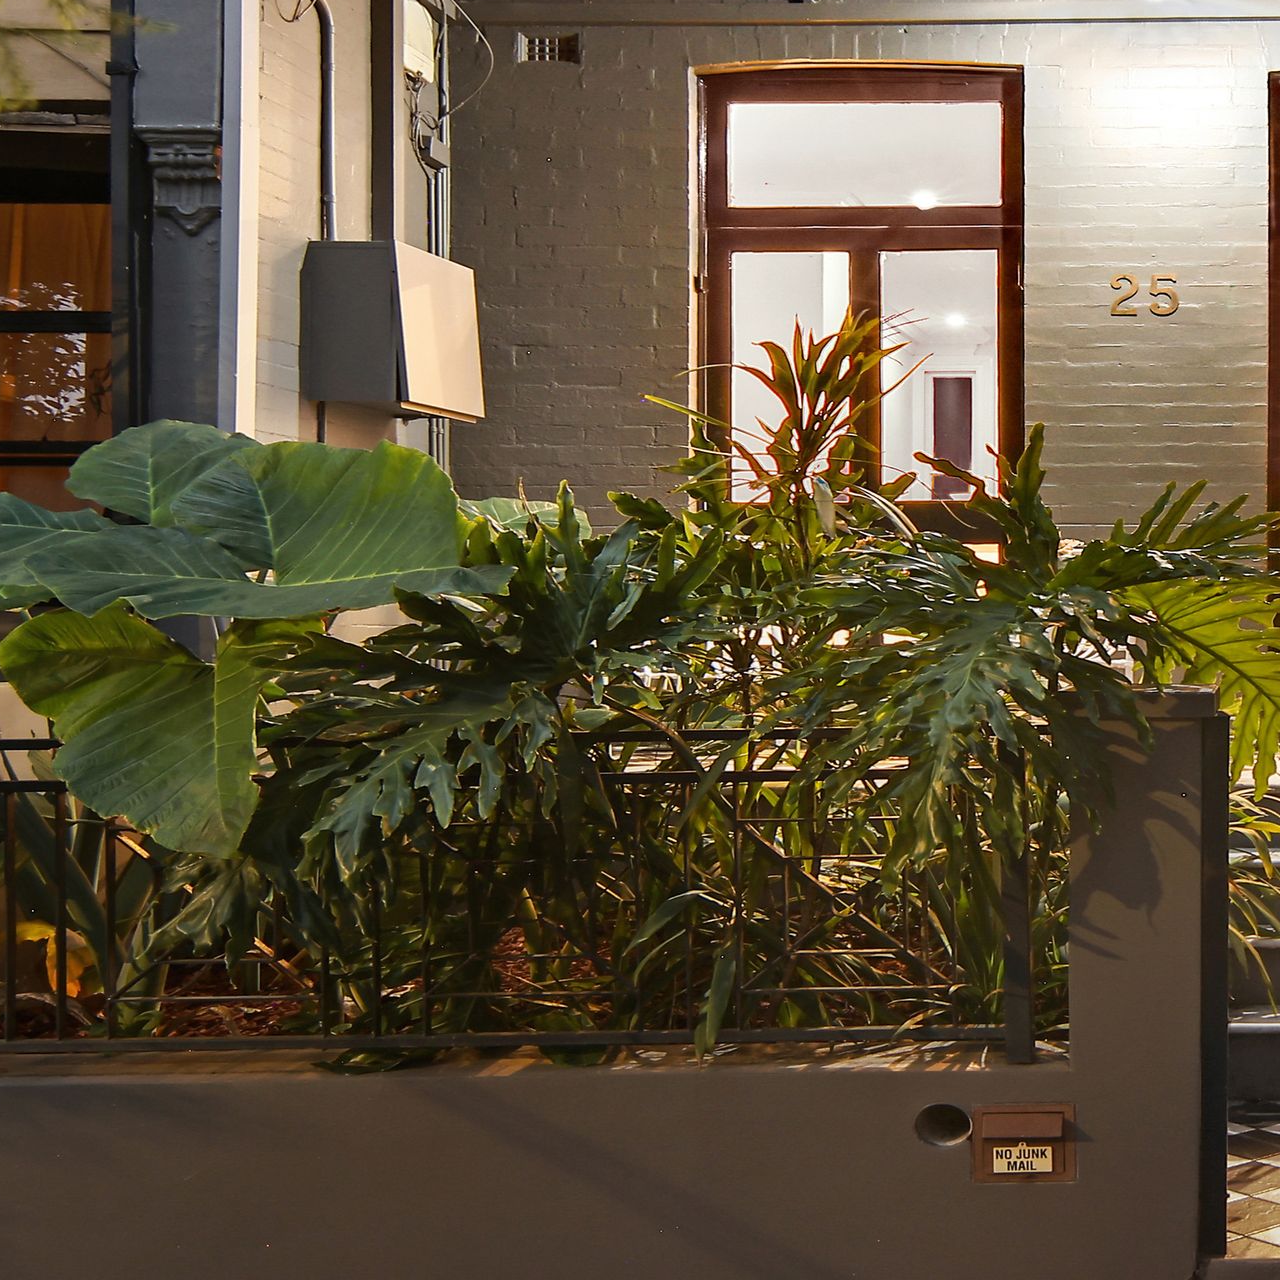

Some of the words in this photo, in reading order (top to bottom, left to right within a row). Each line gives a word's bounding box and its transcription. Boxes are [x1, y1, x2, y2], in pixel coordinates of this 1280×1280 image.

[1109, 273, 1179, 317] 25
[996, 1149, 1013, 1160] NO
[1016, 1148, 1048, 1160] JUNK
[1007, 1160, 1037, 1171] MAIL
